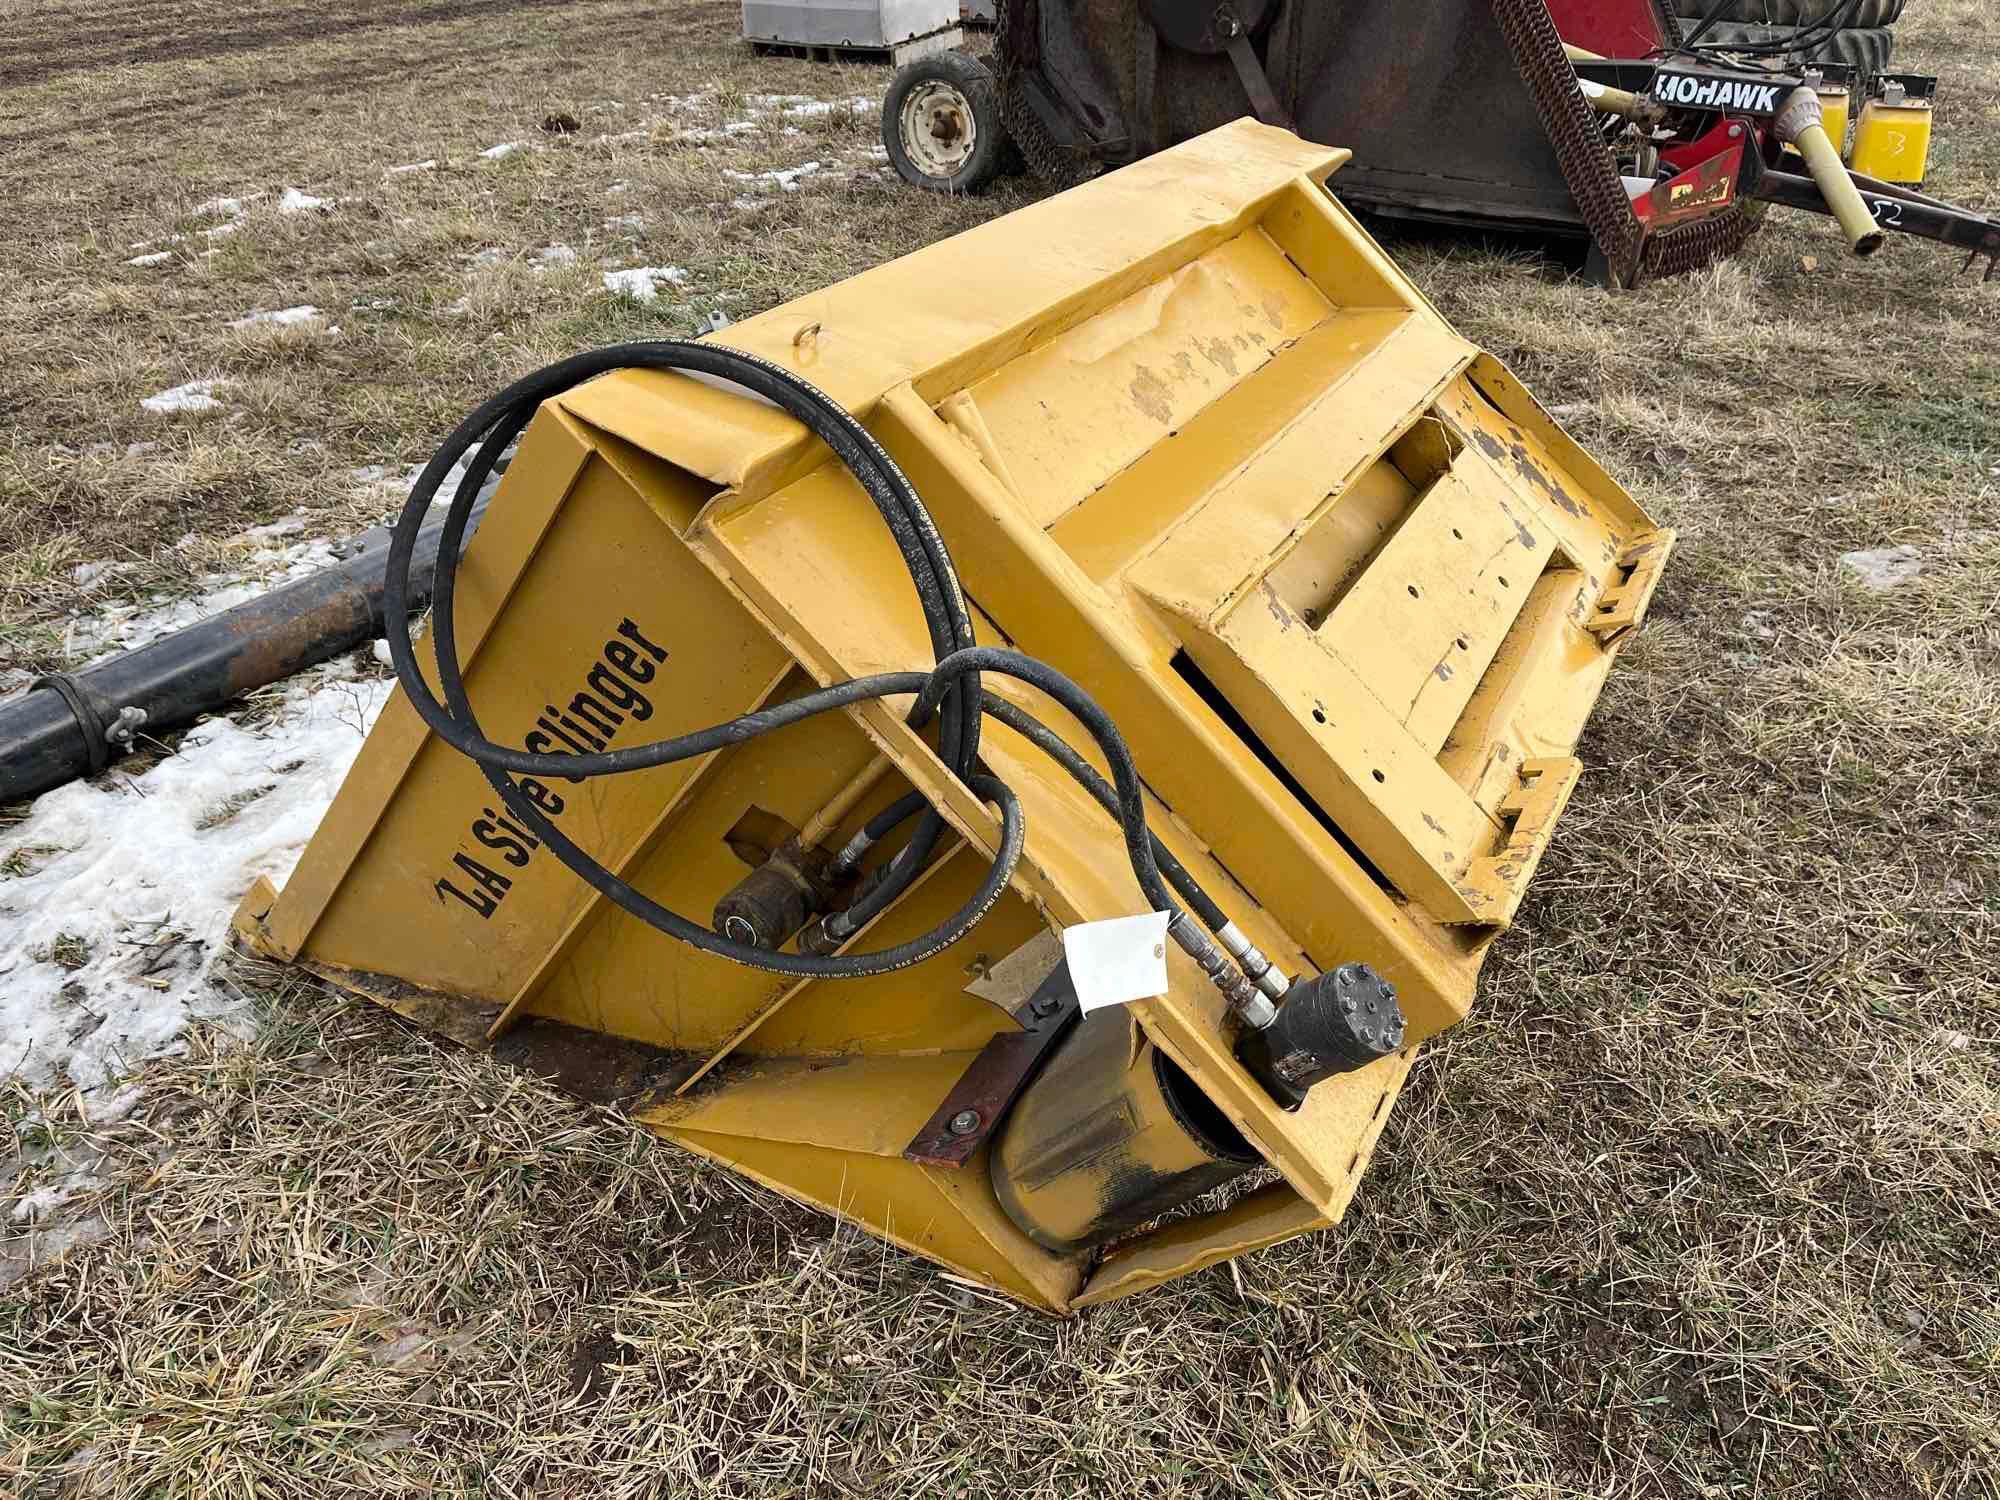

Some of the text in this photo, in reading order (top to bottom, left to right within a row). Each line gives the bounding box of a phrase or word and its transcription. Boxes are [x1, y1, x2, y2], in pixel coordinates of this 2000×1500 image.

[1655, 73, 1780, 112] MOHAWK
[886, 457, 904, 478] INCH
[525, 616, 670, 785] Slinger
